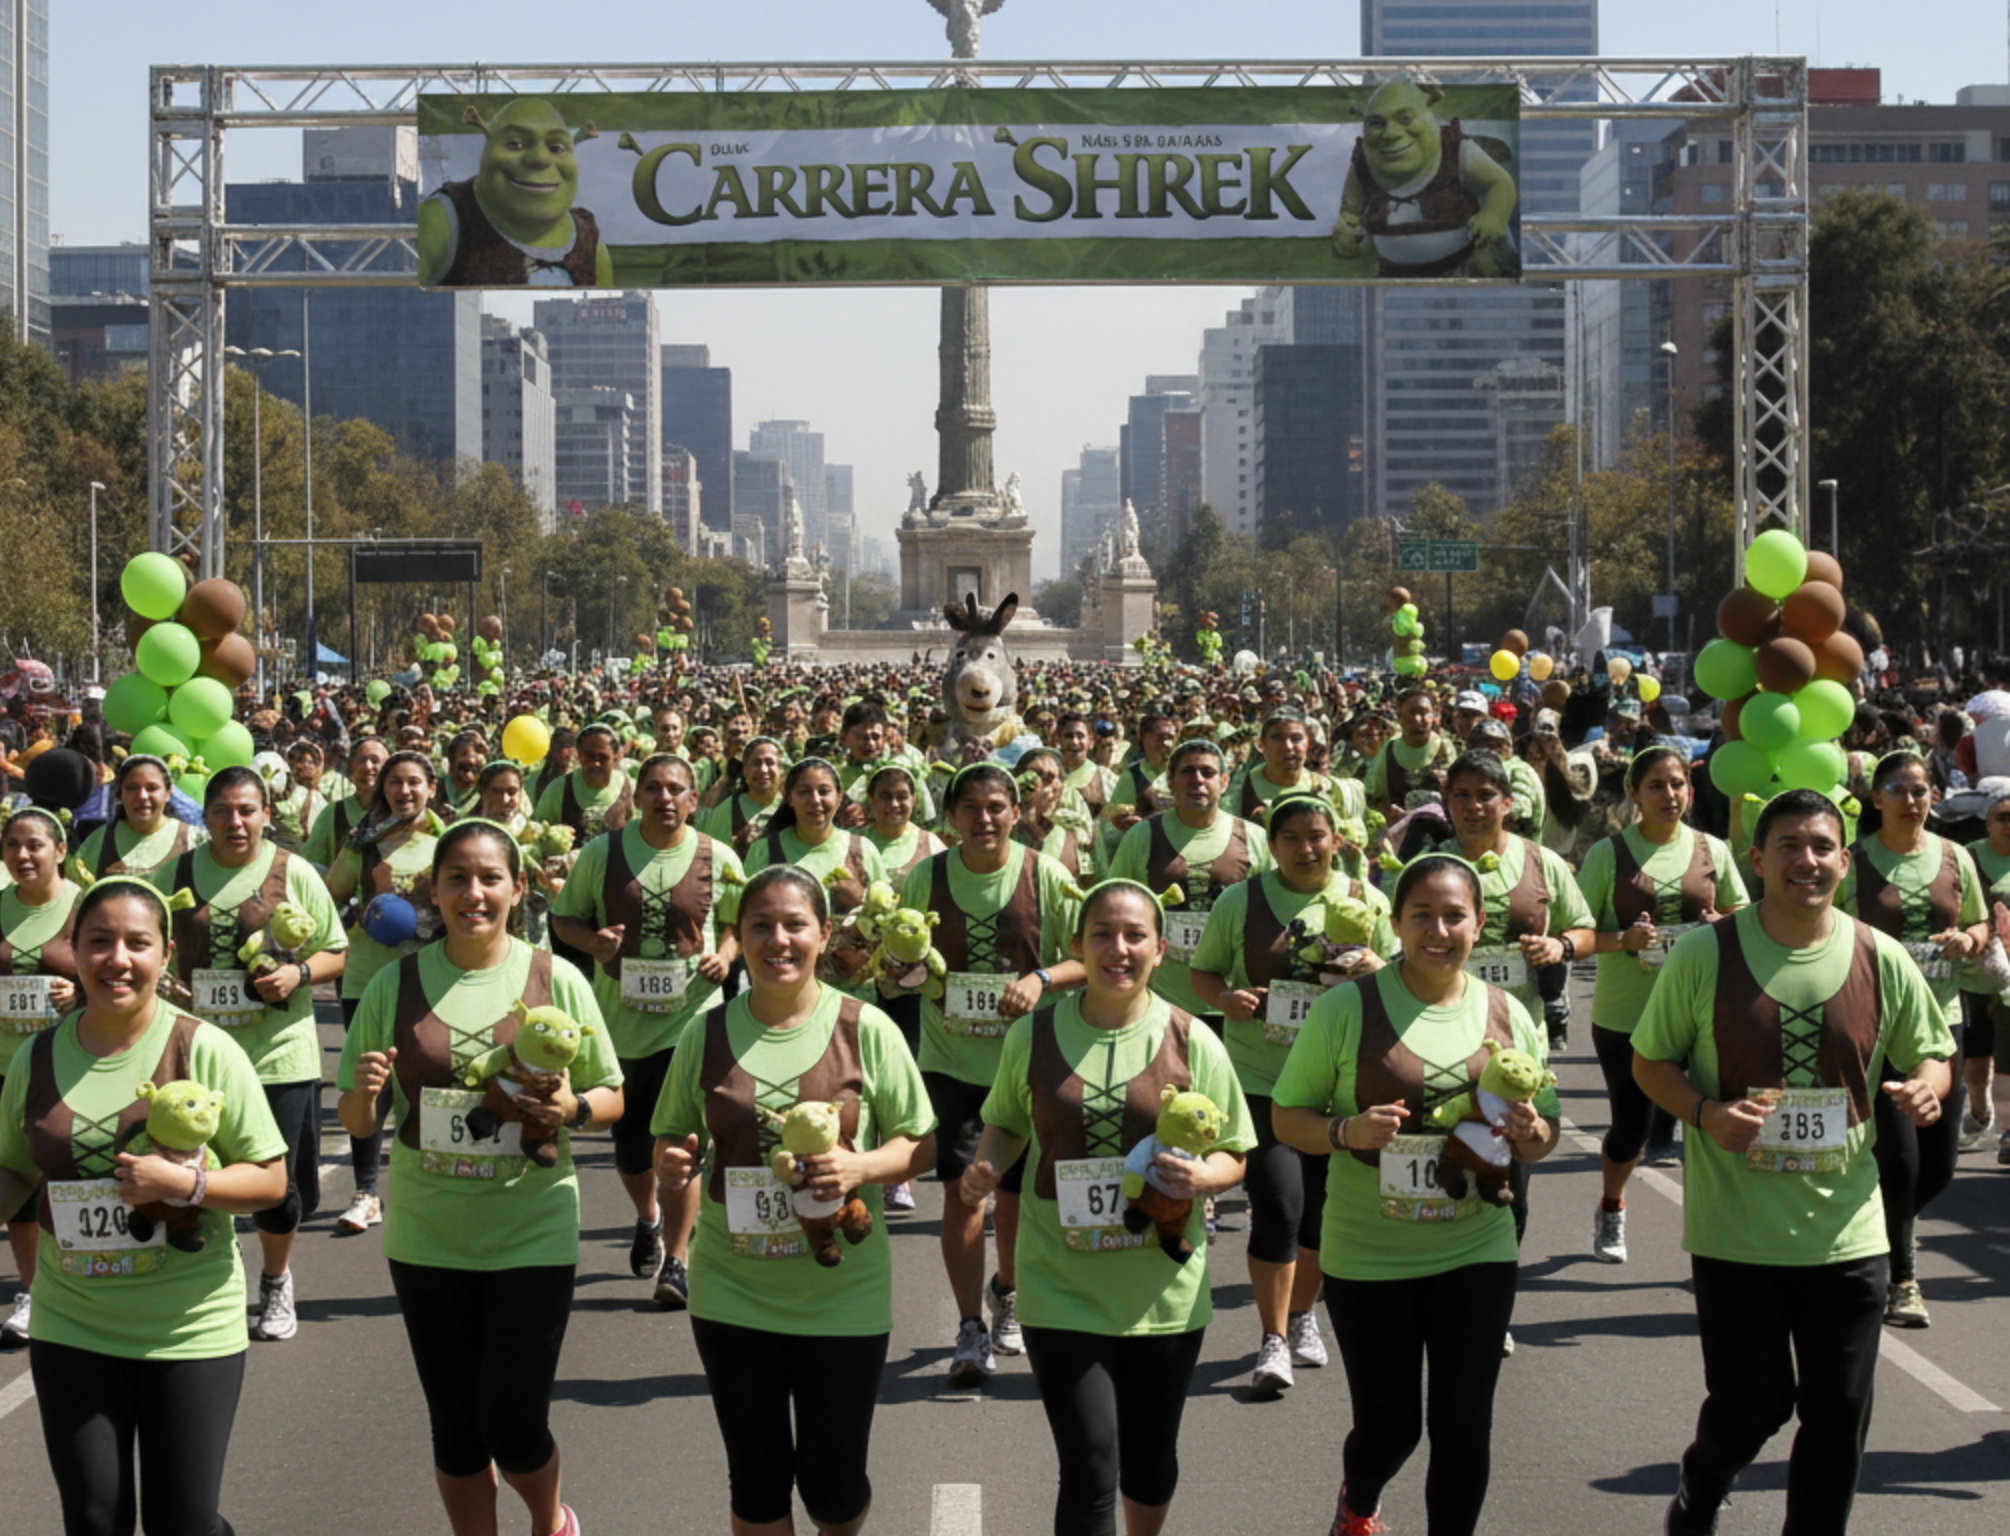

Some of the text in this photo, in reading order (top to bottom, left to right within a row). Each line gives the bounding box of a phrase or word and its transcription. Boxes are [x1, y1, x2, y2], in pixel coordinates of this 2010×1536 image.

[632, 137, 1316, 226] CARRERA SHREK
[1088, 1183, 1121, 1215] 67
